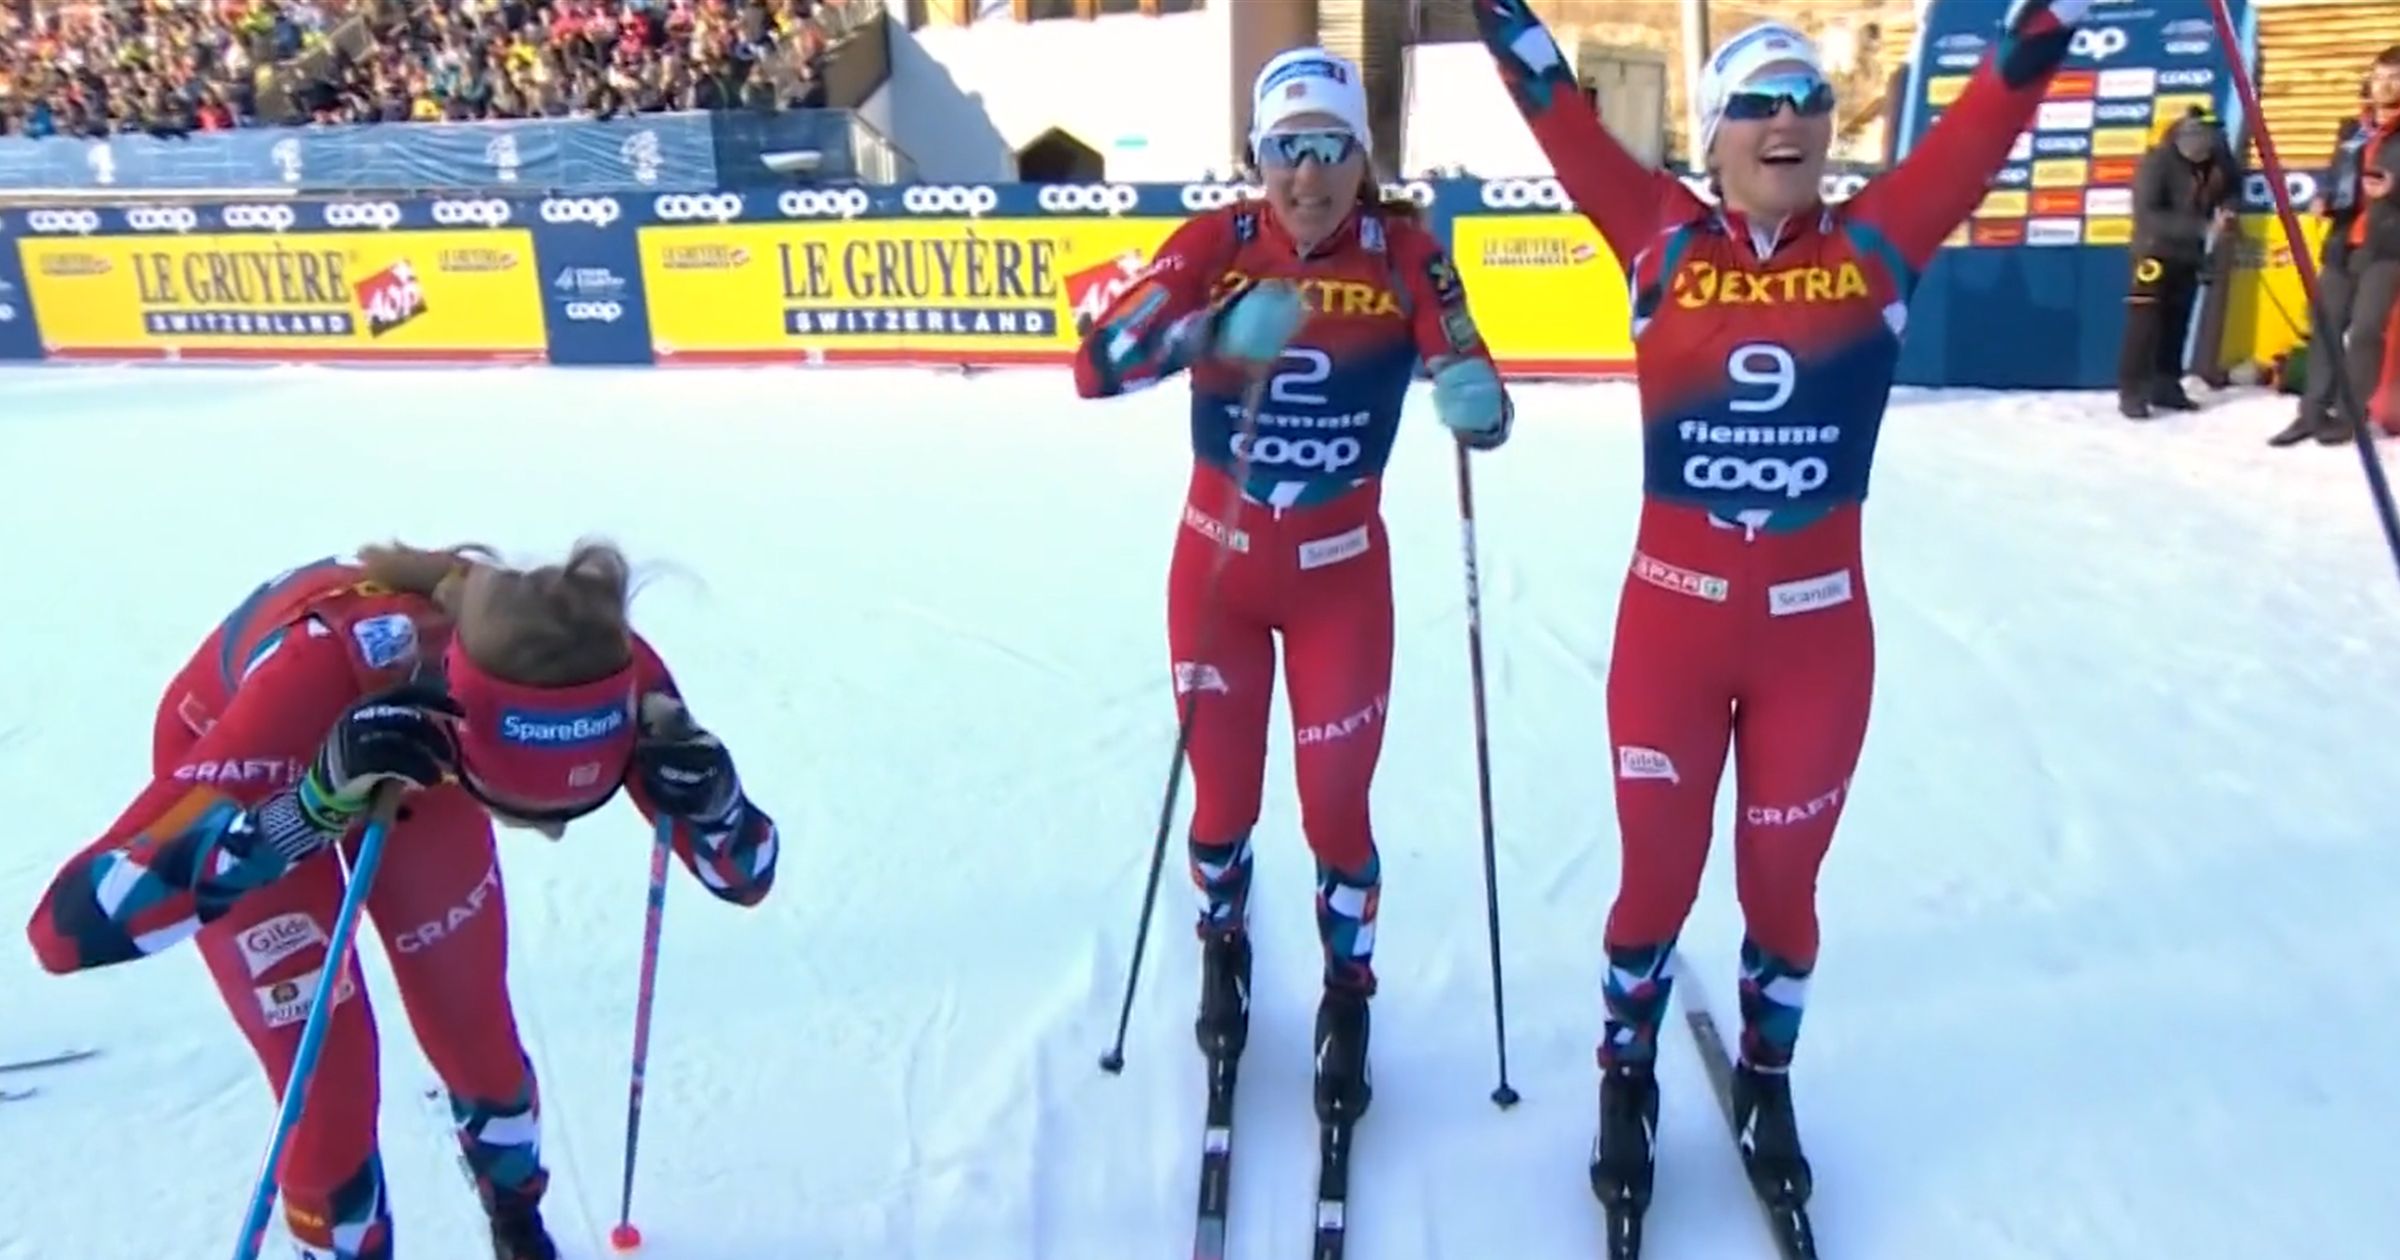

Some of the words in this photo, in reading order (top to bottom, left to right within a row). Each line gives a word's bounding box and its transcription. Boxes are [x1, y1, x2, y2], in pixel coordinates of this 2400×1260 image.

[324, 202, 401, 230] coop
[432, 198, 510, 227] coop
[540, 197, 621, 227] coop
[654, 192, 743, 223] coop
[777, 188, 869, 220] coop
[903, 185, 998, 217] coop
[1038, 184, 1139, 217] coop
[27, 209, 99, 235] coop
[126, 207, 197, 234] coop
[222, 205, 295, 232] coop
[133, 253, 178, 303] LE
[183, 240, 350, 303] GRUYÈRE
[778, 240, 832, 300] LE
[843, 227, 1057, 299] GRUYÈRE
[1298, 278, 1403, 317] XTRA
[1719, 261, 1868, 304] EXTRA
[153, 314, 347, 332] SWITZERLAND
[565, 302, 621, 322] coop
[797, 312, 1044, 333] SWITZERLAND
[1271, 347, 1331, 404] 2
[1727, 342, 1795, 412] 9
[1678, 419, 1841, 444] fiemme
[1230, 432, 1361, 473] coop
[1683, 455, 1829, 498] coop
[1298, 705, 1373, 744] CRAFT
[173, 758, 284, 783] CRAFT
[1747, 788, 1841, 826] CRAFT
[395, 864, 499, 952] CRAFT
